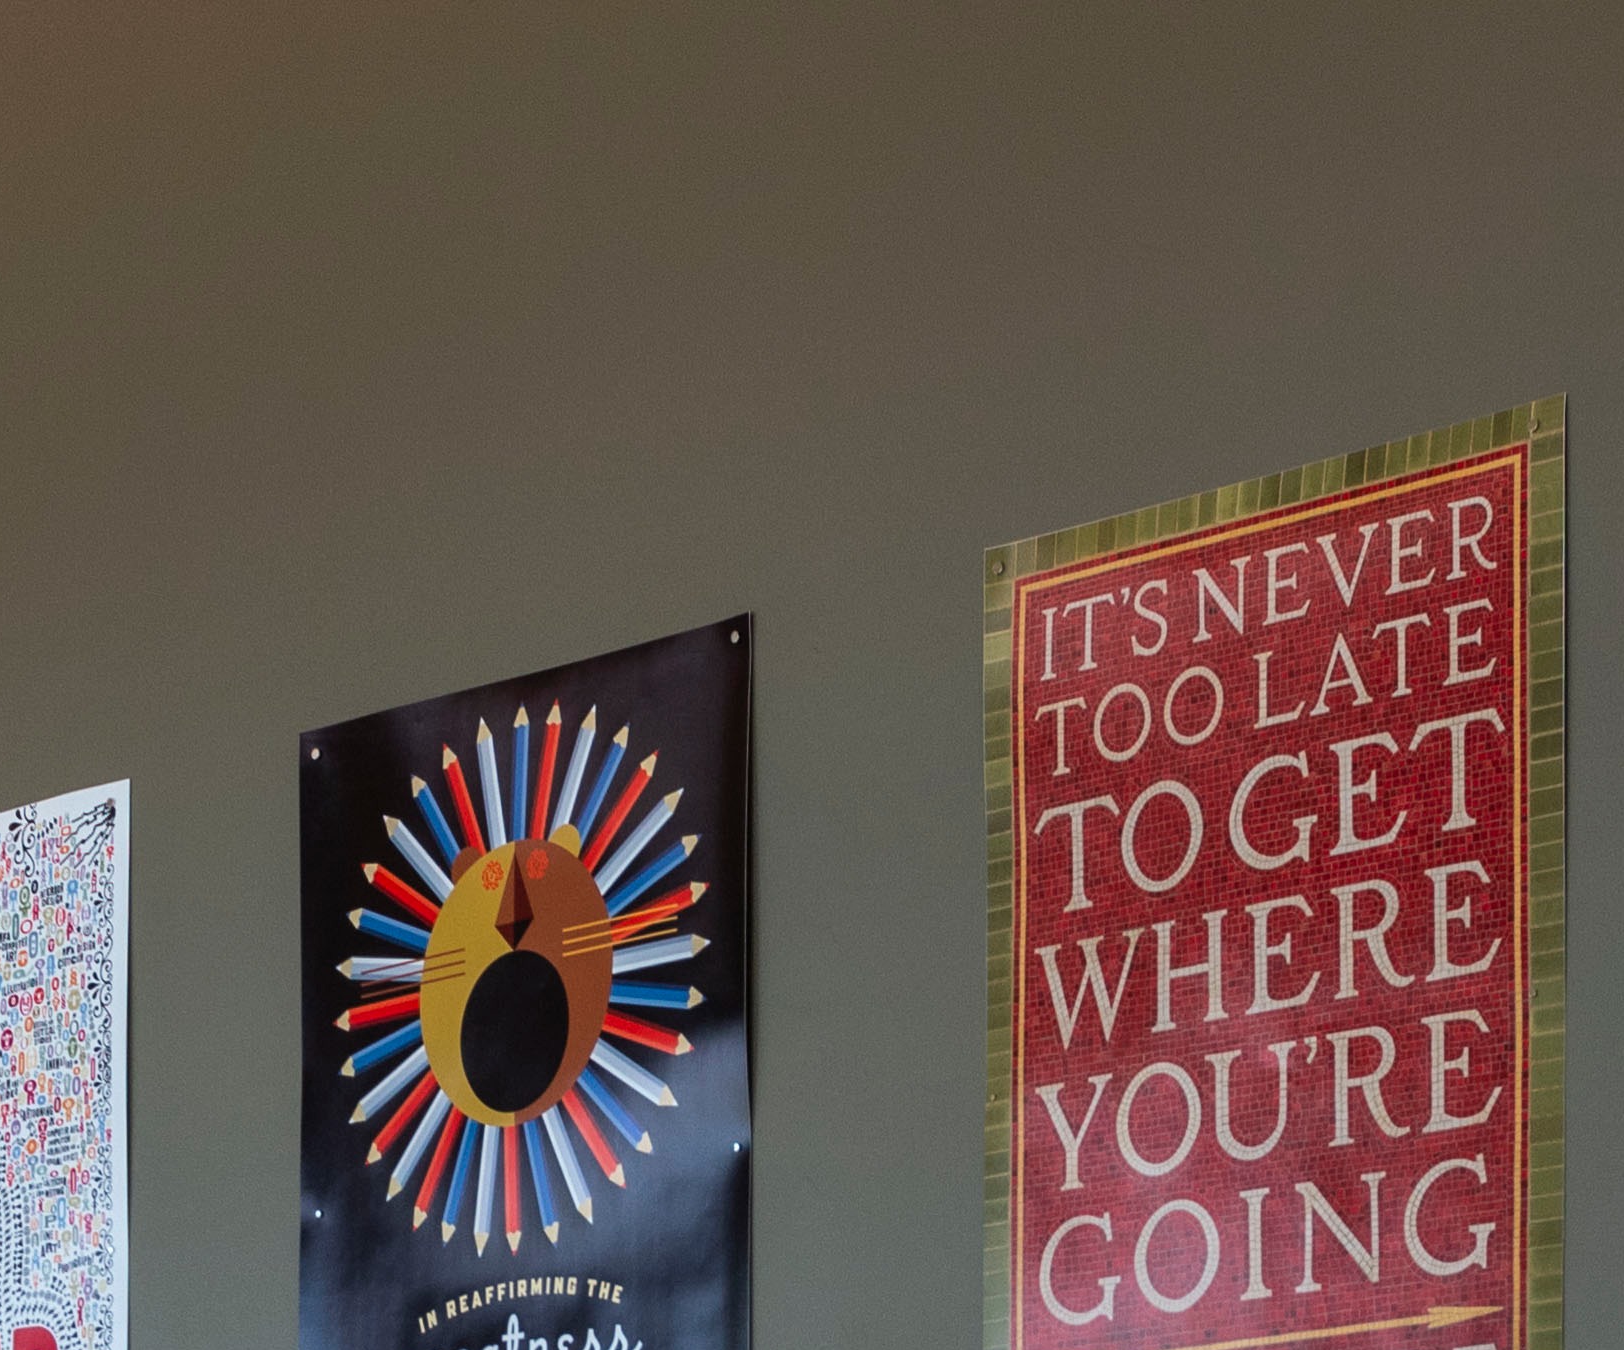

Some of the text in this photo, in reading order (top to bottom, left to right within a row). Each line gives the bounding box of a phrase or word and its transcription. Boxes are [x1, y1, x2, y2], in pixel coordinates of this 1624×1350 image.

[1040, 495, 1497, 681] IT'S NEVER
[1034, 598, 1497, 778] TOO LATE
[1033, 707, 1507, 913] TO GET
[1034, 860, 1504, 1050] WHERE
[1035, 1009, 1504, 1192] YOU'RE
[418, 1276, 624, 1334] IN REAFFIRMING THE
[1039, 1152, 1496, 1327] GOING
